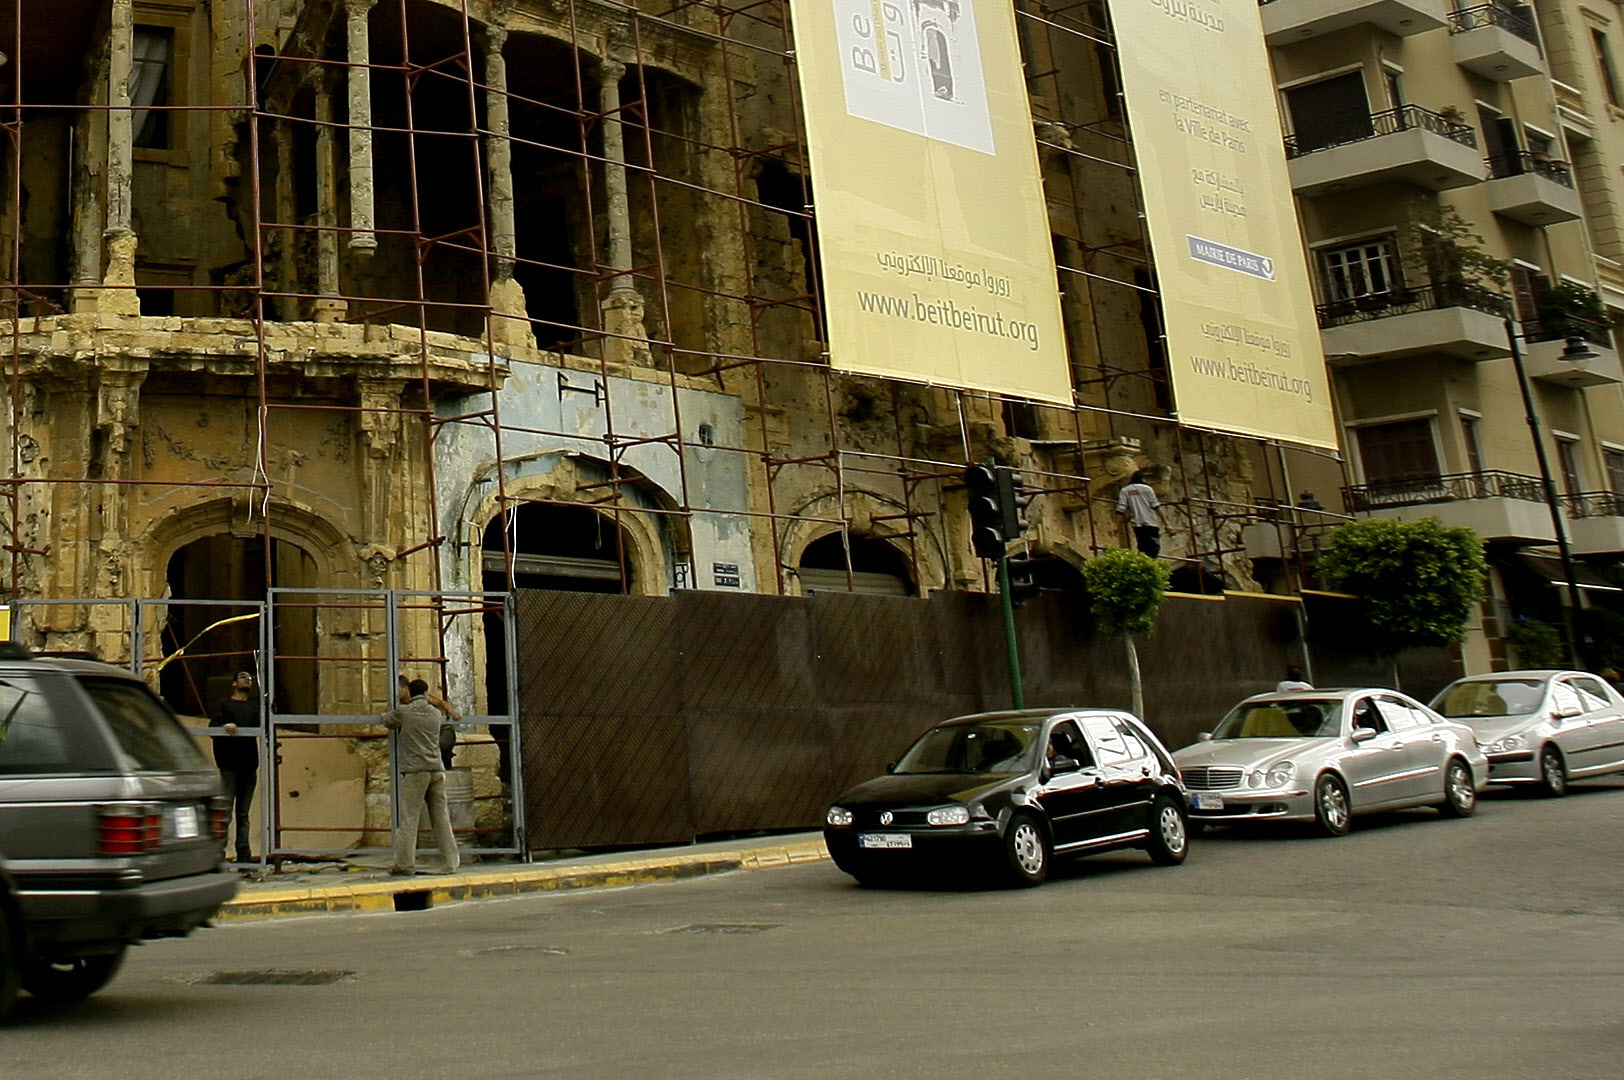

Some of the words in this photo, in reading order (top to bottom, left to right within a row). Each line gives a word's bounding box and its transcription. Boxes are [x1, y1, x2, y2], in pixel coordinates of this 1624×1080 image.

[1196, 243, 1225, 262] MAIRIE
[1226, 251, 1237, 265] DE
[1238, 255, 1259, 271] PARIS
[939, 259, 981, 289] موقعنا
[982, 269, 1011, 297] زوروا
[857, 290, 1039, 351] www.beitbeirut.org
[1190, 356, 1312, 403] www.beitbeirut.org
